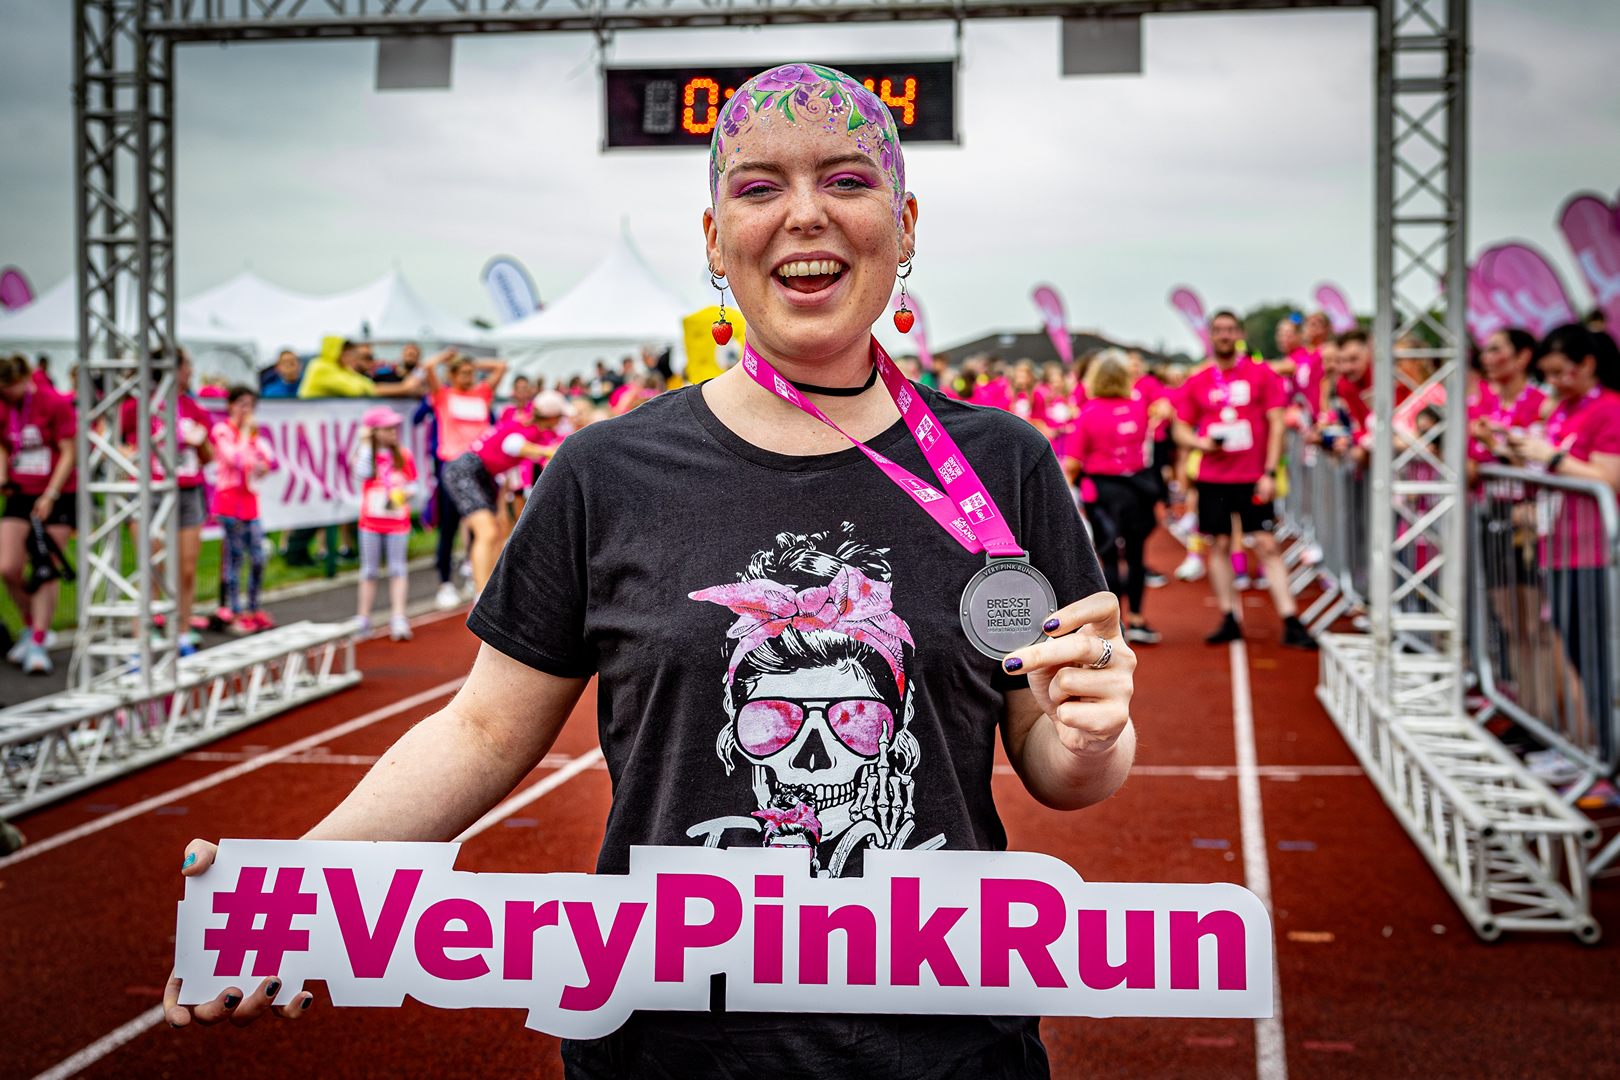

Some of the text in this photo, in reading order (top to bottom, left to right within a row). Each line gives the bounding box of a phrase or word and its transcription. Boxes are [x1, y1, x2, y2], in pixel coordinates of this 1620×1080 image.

[982, 565, 999, 576] VERY
[1017, 565, 1032, 575] RUN
[986, 608, 1031, 619] CANCER
[986, 618, 1032, 628] IRELAND
[203, 865, 1249, 1011] #VeryPinkRun
